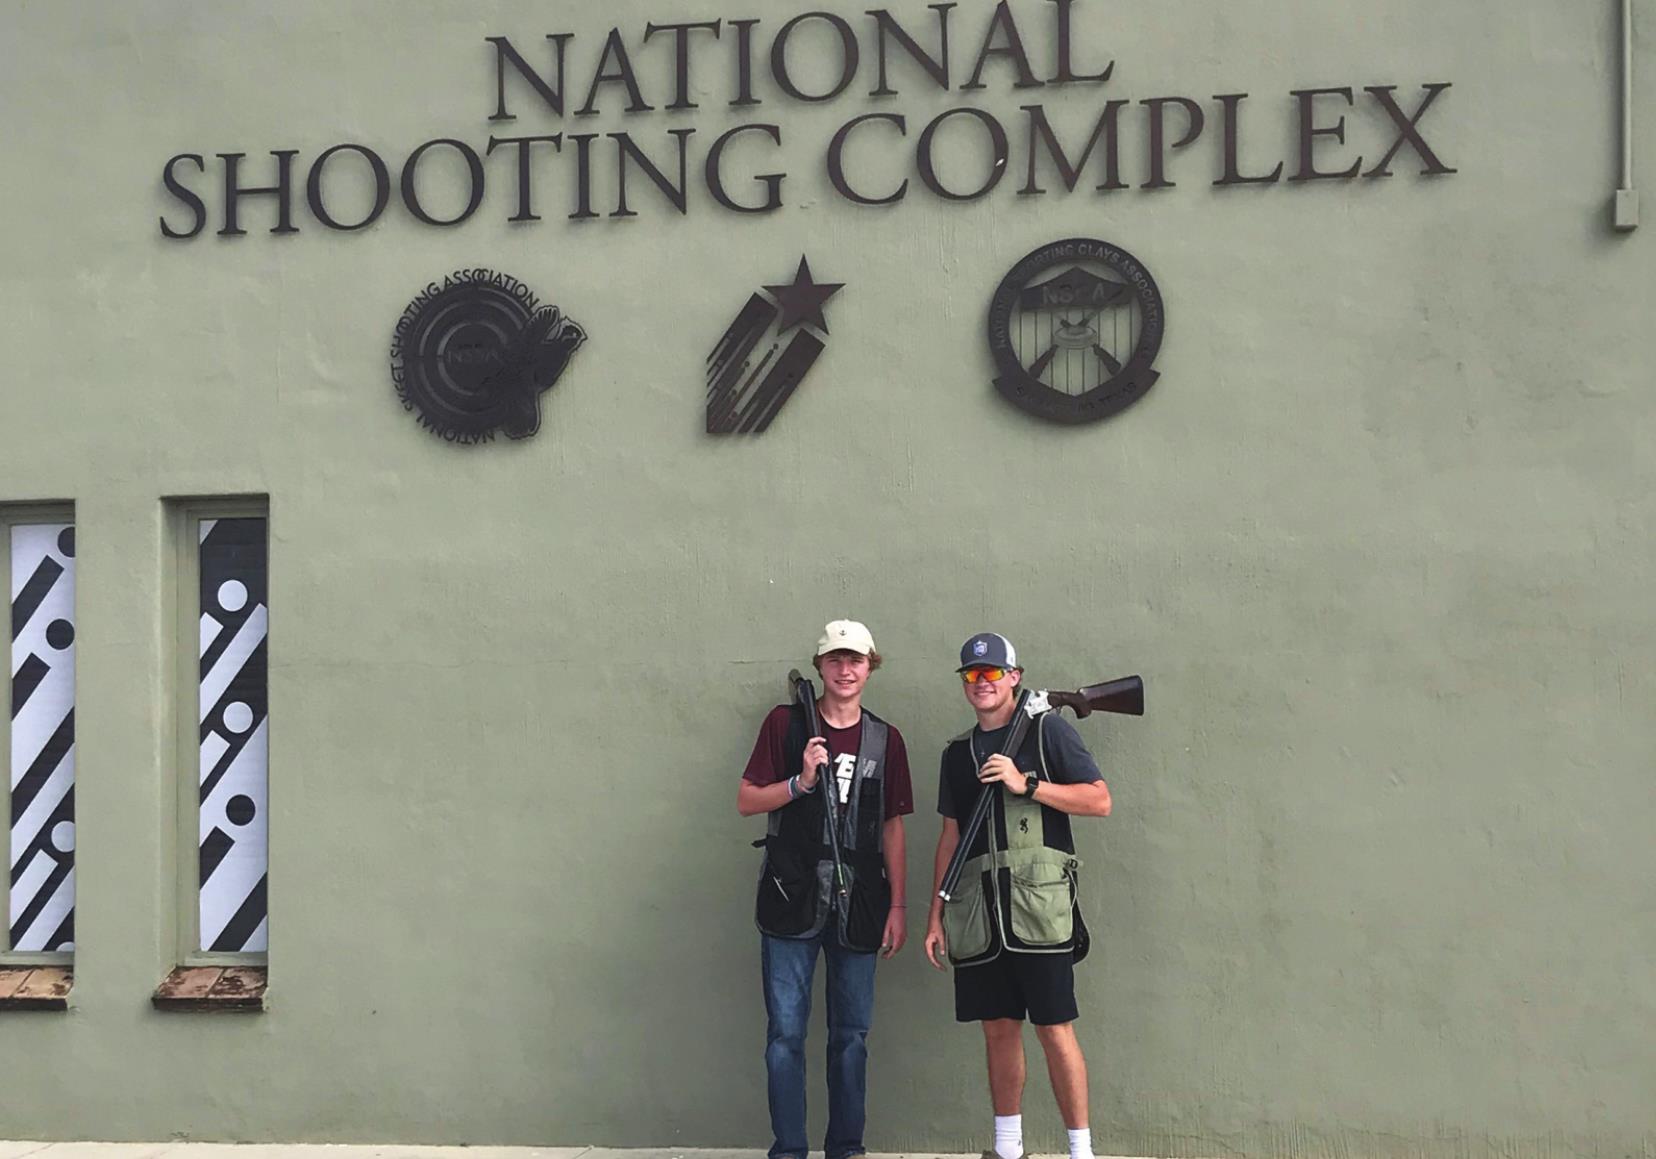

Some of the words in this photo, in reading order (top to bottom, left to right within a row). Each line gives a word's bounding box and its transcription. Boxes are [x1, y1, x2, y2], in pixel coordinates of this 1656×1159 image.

[485, 0, 1113, 120] NATIONAL
[160, 125, 786, 239] SHOOTING
[827, 82, 1456, 205] COMPLEX
[1077, 243, 1120, 265] CLAYS
[390, 281, 441, 359] SHOOTING
[444, 268, 540, 309] ASSOCIATION
